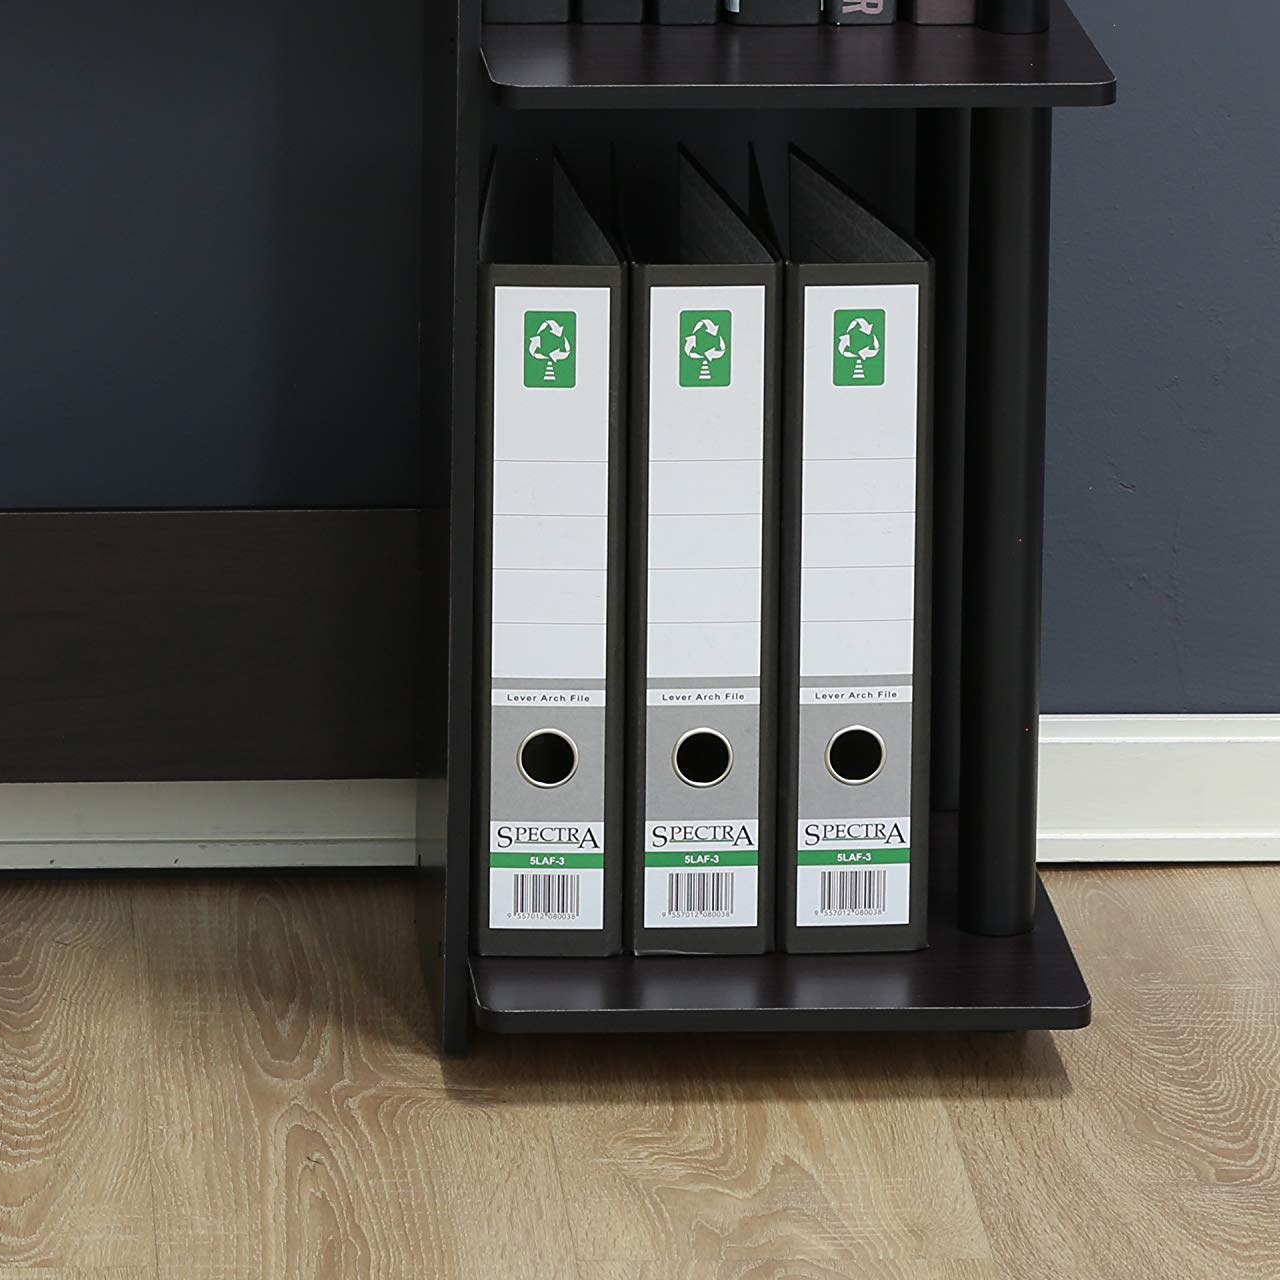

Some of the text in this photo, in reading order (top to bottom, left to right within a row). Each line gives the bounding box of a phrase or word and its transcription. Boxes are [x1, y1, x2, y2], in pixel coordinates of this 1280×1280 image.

[507, 694, 590, 702] Lever Arch File
[662, 693, 745, 701] Lever Arch File
[815, 691, 897, 700] Lever Arch File
[497, 826, 600, 849] SPECTRA
[652, 825, 755, 848] SPECTRA
[804, 823, 907, 846] SPECTRA
[530, 856, 565, 866] 5LAF-3
[684, 855, 719, 864] 5LAF-3
[837, 853, 872, 862] 5LAF-3
